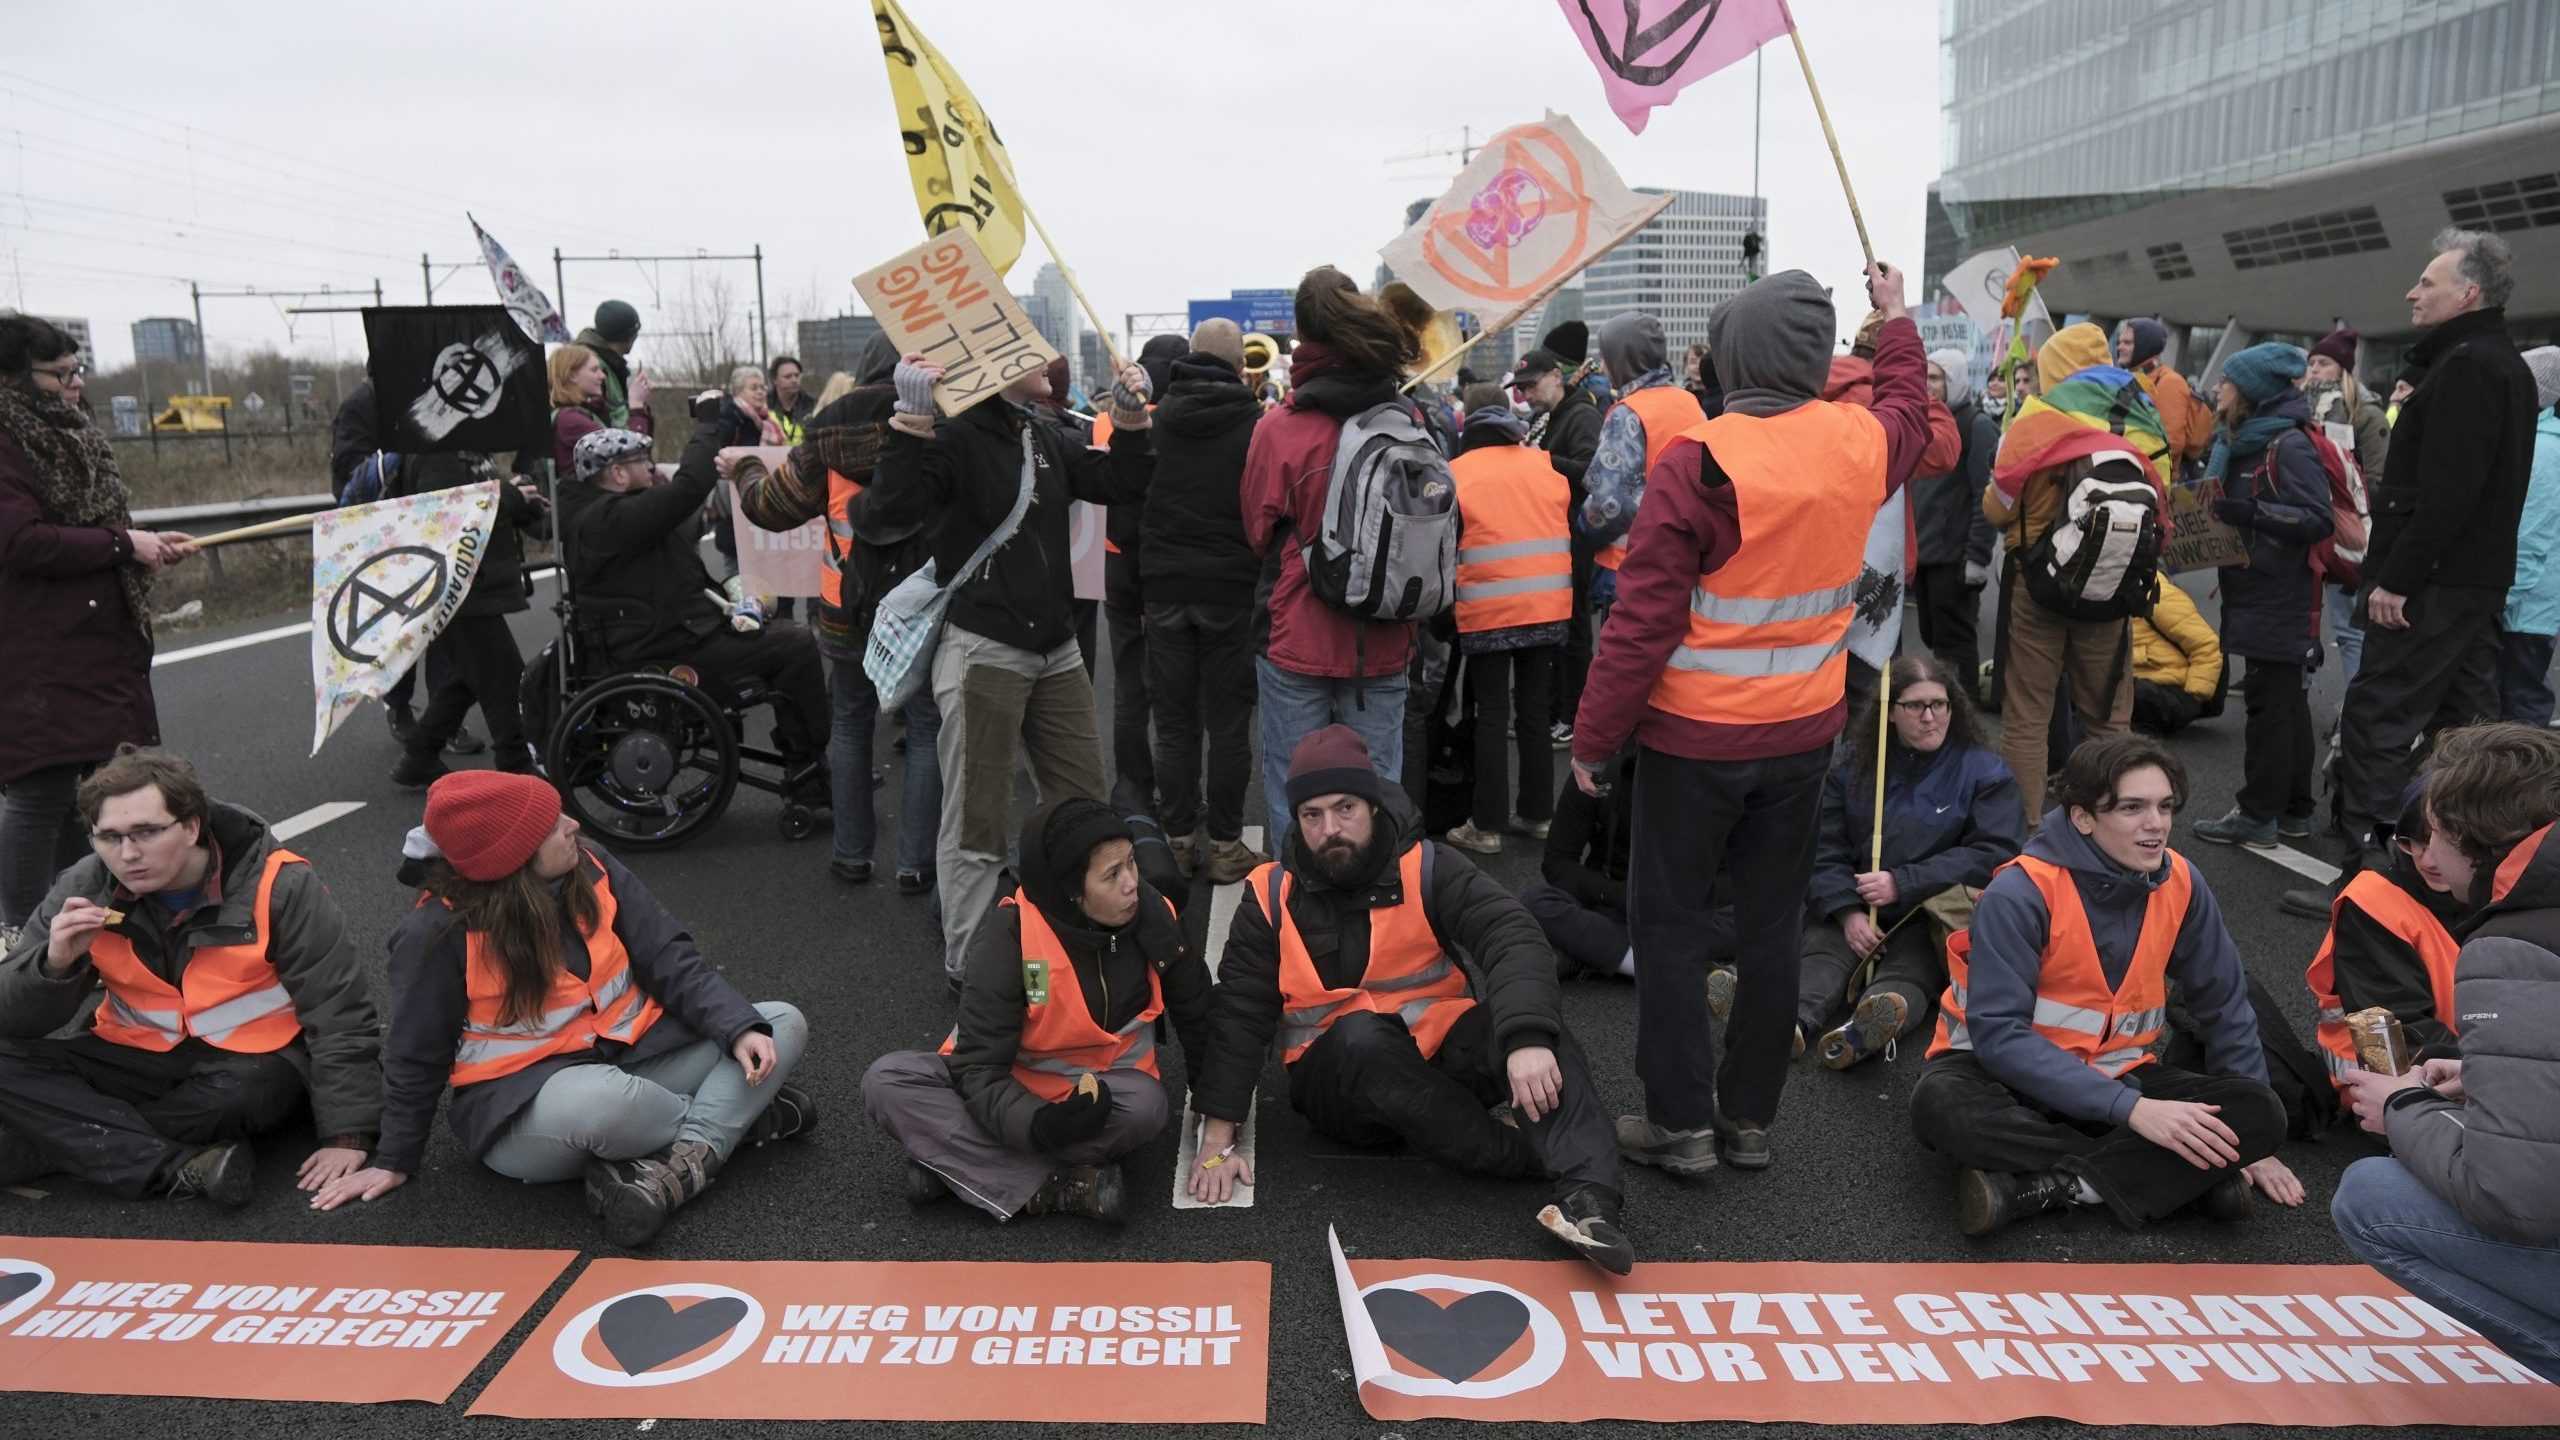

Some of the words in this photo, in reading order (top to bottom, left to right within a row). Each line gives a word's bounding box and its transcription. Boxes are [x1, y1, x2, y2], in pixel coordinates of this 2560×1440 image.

[56, 1281, 192, 1309] WEG
[192, 1284, 318, 1312] VON
[312, 1287, 505, 1317] FOSSIL
[1569, 1291, 1889, 1336] LETZTE
[9, 1309, 136, 1339] HIN
[122, 1312, 218, 1342] ZU
[211, 1315, 487, 1348] GERECHT
[781, 1304, 910, 1332] WEG
[924, 1305, 1038, 1332] VON
[1050, 1304, 1242, 1333] FOSSIL
[761, 1335, 874, 1364] HIN
[879, 1335, 959, 1365] ZU
[970, 1335, 1242, 1366] GERECHT
[1581, 1340, 1768, 1383] VOR
[1774, 1342, 1952, 1383] DEN
